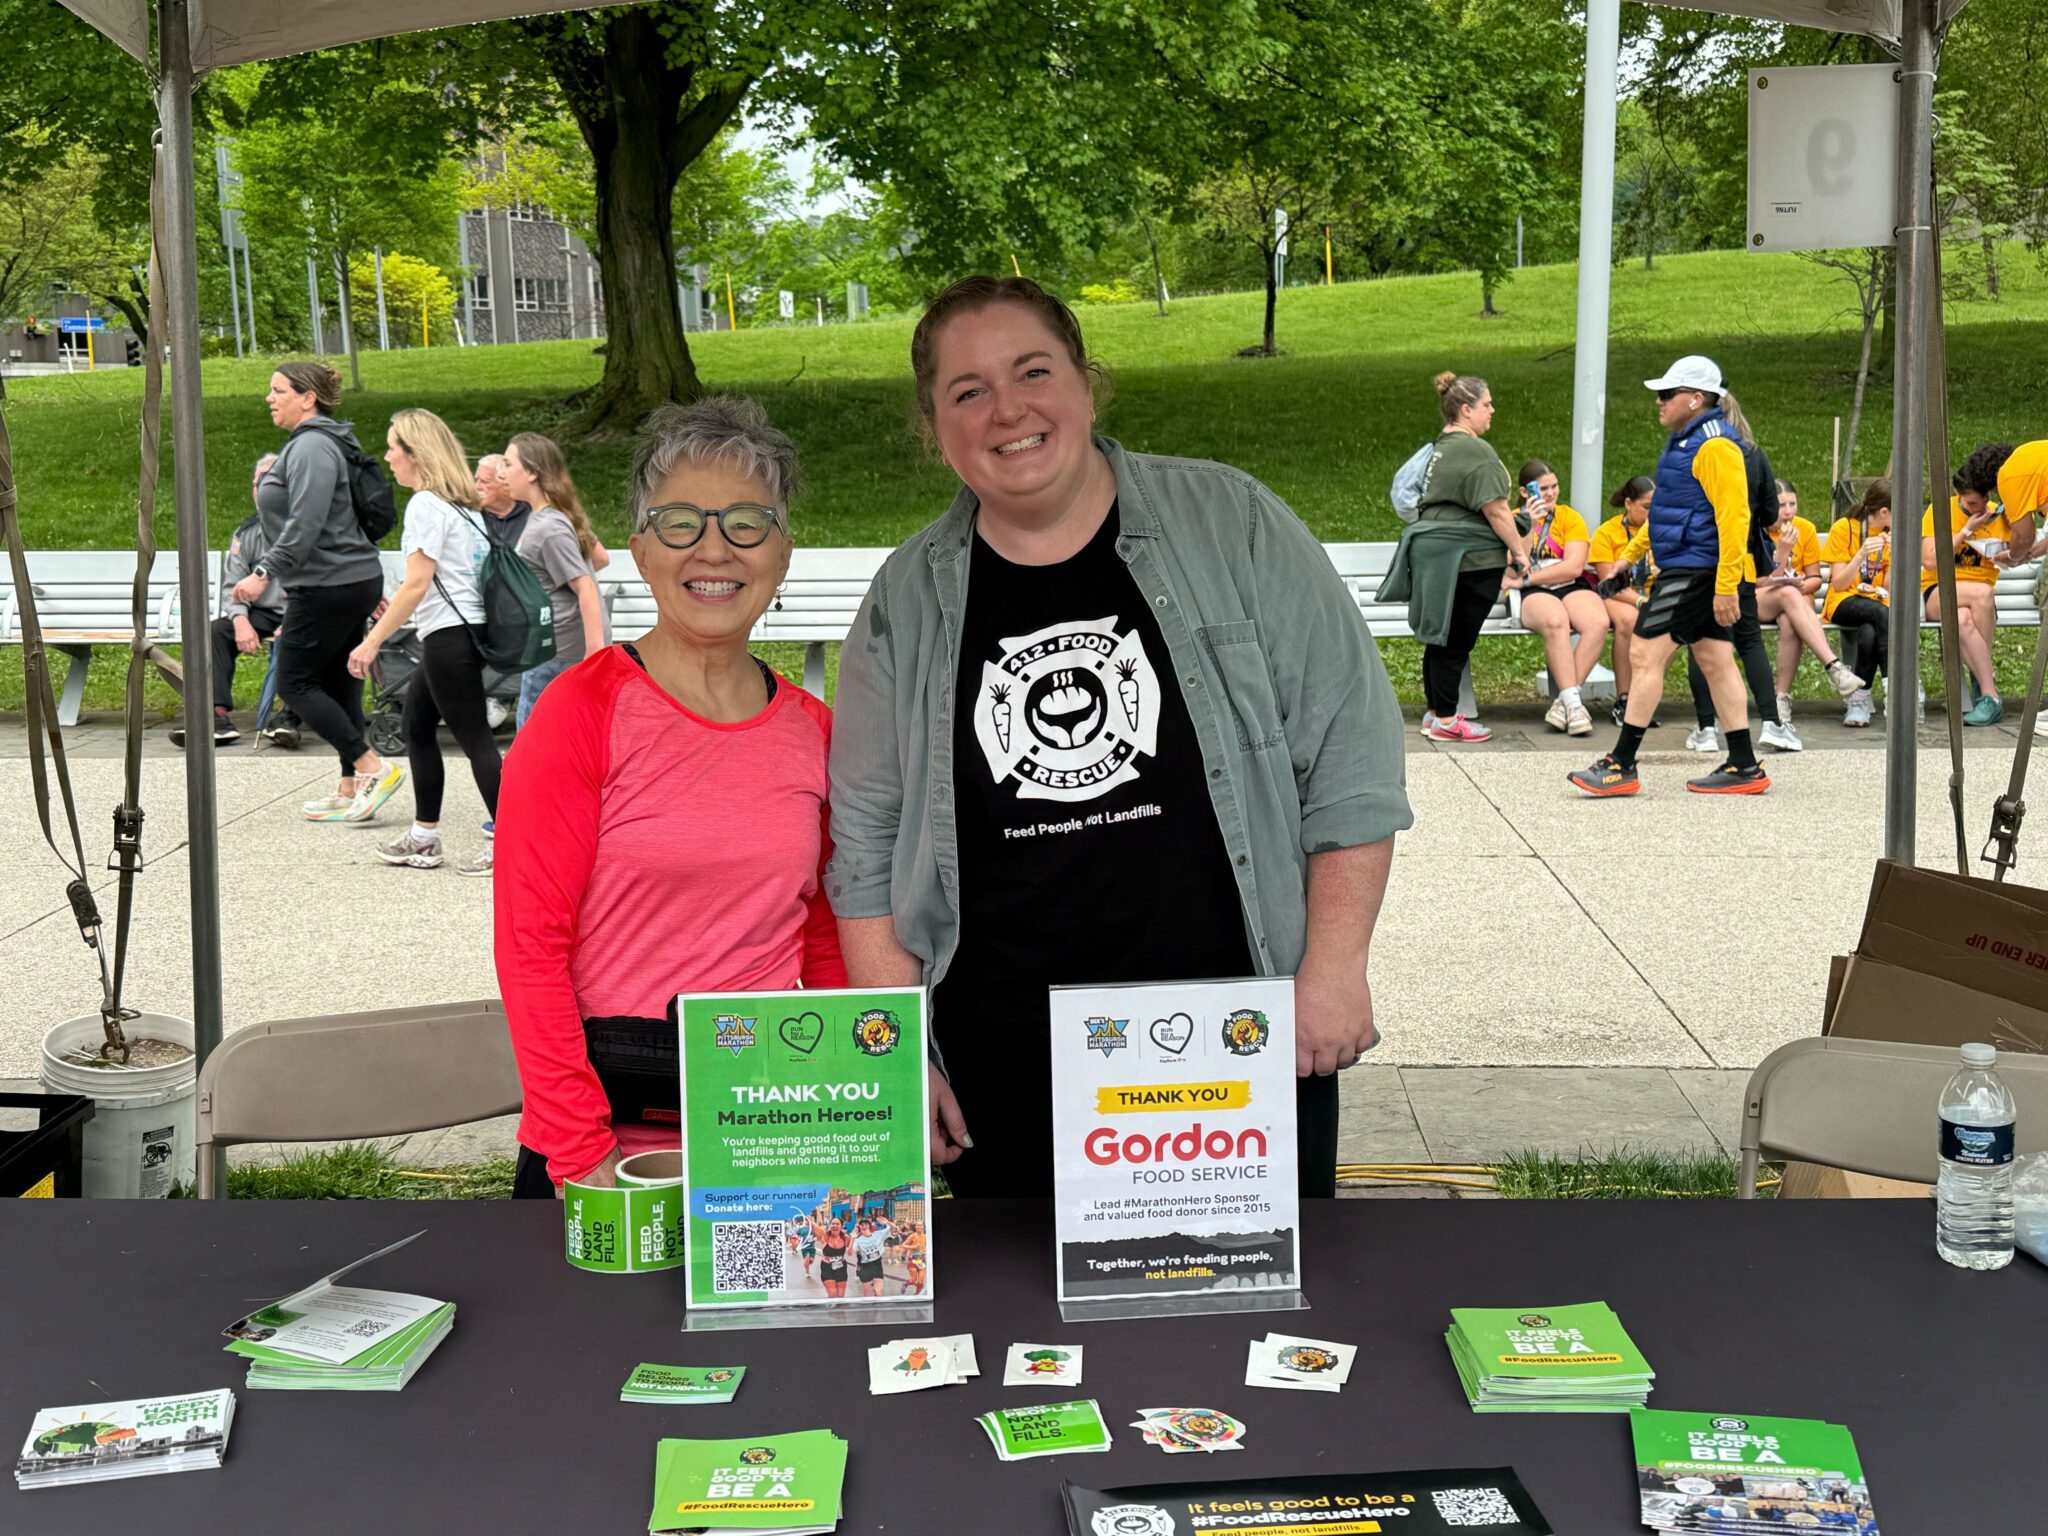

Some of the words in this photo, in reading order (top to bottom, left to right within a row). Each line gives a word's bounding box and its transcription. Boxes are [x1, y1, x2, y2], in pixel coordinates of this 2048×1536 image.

[1009, 645, 1046, 672] 412
[1058, 634, 1112, 655] FOOD
[1032, 752, 1122, 788] RESCUE
[1004, 825, 1036, 839] Feed
[1038, 819, 1083, 835] People
[1085, 813, 1103, 827] Not
[1106, 803, 1162, 824] Landfills
[1965, 933, 1988, 951] UP
[1990, 940, 2024, 961] END
[863, 1013, 885, 1022] FOOD
[1232, 1013, 1254, 1022] FOOD
[871, 1032, 896, 1052] RESCUE
[1239, 1032, 1265, 1052] RESCUE
[731, 1084, 821, 1104] THANK
[825, 1082, 880, 1100] YOU
[1118, 1090, 1184, 1105] THANK
[1187, 1088, 1228, 1102] YOU
[717, 1109, 812, 1126] Marathon
[818, 1106, 892, 1123] Heroes!
[722, 1136, 756, 1146] You're
[759, 1135, 800, 1147] keeping
[804, 1133, 830, 1146] good
[833, 1133, 857, 1143] food
[860, 1132, 876, 1142] out
[880, 1131, 891, 1141] of
[733, 1146, 774, 1157] landfills
[777, 1145, 796, 1155] and
[800, 1144, 837, 1156] getting
[840, 1144, 847, 1153] it
[849, 1144, 860, 1153] to
[863, 1144, 880, 1152] our
[732, 1156, 785, 1169] neighbors
[788, 1156, 810, 1165] who
[813, 1154, 839, 1164] need
[842, 1154, 849, 1163] it
[852, 1154, 881, 1163] most.
[1133, 1170, 1185, 1184] FOOD
[1191, 1165, 1267, 1182] SERVICE
[705, 1192, 749, 1204] Support
[752, 1193, 770, 1201] our
[773, 1190, 817, 1200] runners!
[1094, 1200, 1120, 1210] Lead
[1124, 1196, 1211, 1208] #MarathonHero
[1214, 1194, 1261, 1205] Sponsor
[705, 1203, 743, 1213] Donate
[746, 1202, 773, 1212] here:
[1084, 1211, 1105, 1221] and
[1108, 1210, 1144, 1220] valued
[1147, 1208, 1173, 1218] food
[1175, 1207, 1208, 1217] donor
[1211, 1205, 1241, 1215] since
[1244, 1203, 1271, 1213] 2015
[574, 1199, 583, 1259] PEOPLE,
[653, 1200, 665, 1261] PEOPLE,
[583, 1229, 592, 1260] NOT
[593, 1221, 602, 1262] LAND
[605, 1221, 614, 1263] FILLS.
[640, 1225, 651, 1262] FEED
[666, 1228, 675, 1259] NOT
[1087, 1259, 1146, 1272] Together,
[1148, 1256, 1181, 1267] we're
[1183, 1254, 1228, 1266] feeding
[1231, 1251, 1273, 1264] people,
[1145, 1269, 1166, 1279] not
[1168, 1267, 1216, 1278] landfills.
[1526, 1328, 1580, 1336] FEELS
[1562, 1334, 1584, 1342] TO
[1512, 1342, 1560, 1354] BE
[1569, 1342, 1595, 1353] A
[144, 1398, 220, 1414] HAPPY
[145, 1405, 218, 1420] EARTH
[136, 1412, 217, 1428] MONTH
[1007, 1414, 1044, 1424] NOT
[1010, 1420, 1060, 1432] LAND
[1013, 1428, 1066, 1442] FILLS.
[1688, 1431, 1706, 1439] IT
[1713, 1433, 1778, 1443] FEELS
[1688, 1438, 1747, 1447] GOOD
[1750, 1441, 1780, 1450] TO
[1690, 1447, 1743, 1462] BE
[1755, 1450, 1786, 1464] A
[714, 1468, 732, 1476] IT
[736, 1467, 795, 1475] FEELS
[1664, 1463, 1816, 1475] #FOODRESCUEHERO
[711, 1474, 763, 1482] GOOD
[770, 1474, 794, 1482] TO
[706, 1483, 755, 1498] BE
[764, 1483, 792, 1497] A
[684, 1502, 808, 1510] #FoodRescueHero
[1188, 1503, 1203, 1514] It
[1209, 1500, 1262, 1512] feels
[1269, 1494, 1330, 1511] good
[1335, 1495, 1360, 1506] to
[1365, 1493, 1395, 1505] be
[1401, 1494, 1416, 1503] a
[1191, 1507, 1411, 1527] #FoodRescueHero
[1291, 1527, 1310, 1535] not
[1314, 1524, 1364, 1534] landfills.
